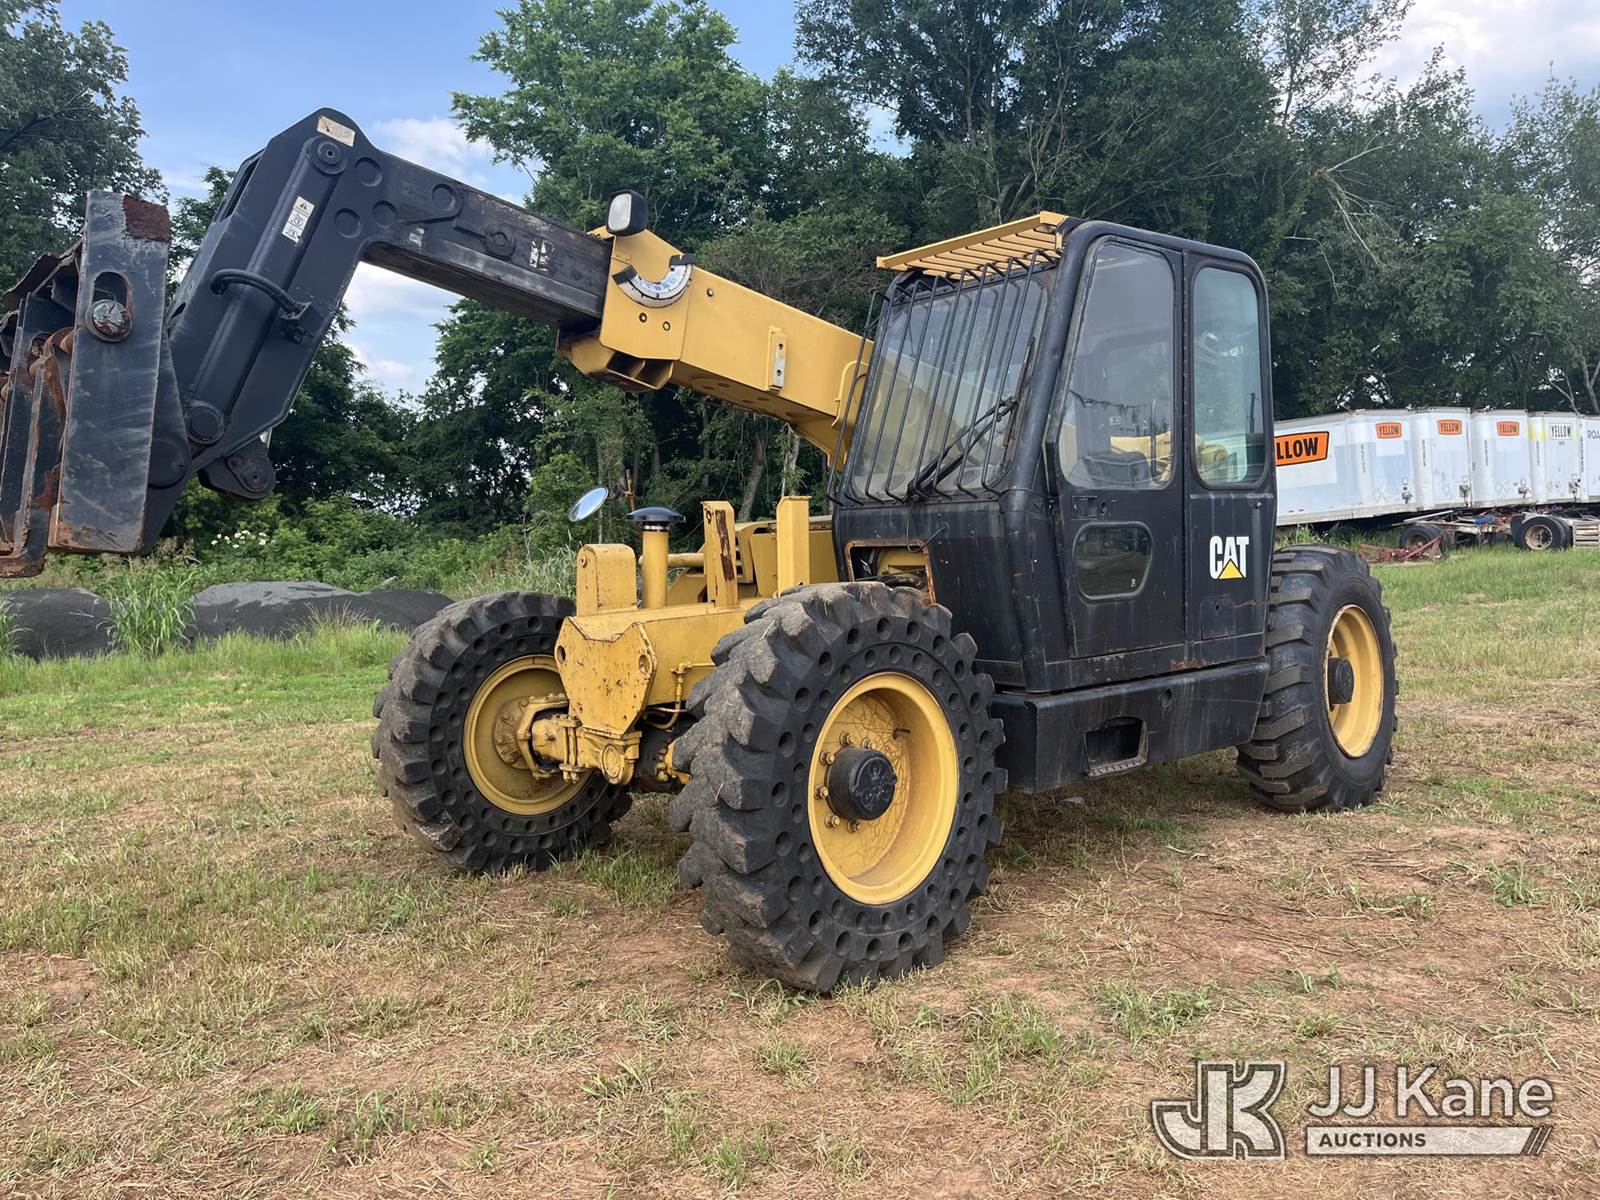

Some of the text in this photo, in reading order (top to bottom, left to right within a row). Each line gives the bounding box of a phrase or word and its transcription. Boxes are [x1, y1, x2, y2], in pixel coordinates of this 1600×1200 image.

[1379, 426, 1399, 436] YELLOW
[1440, 423, 1460, 433] YELLOW
[1551, 425, 1572, 438] YELLOW
[1587, 430, 1600, 440] ROA
[1276, 437, 1319, 460] LLOW
[1210, 535, 1250, 580] CAT
